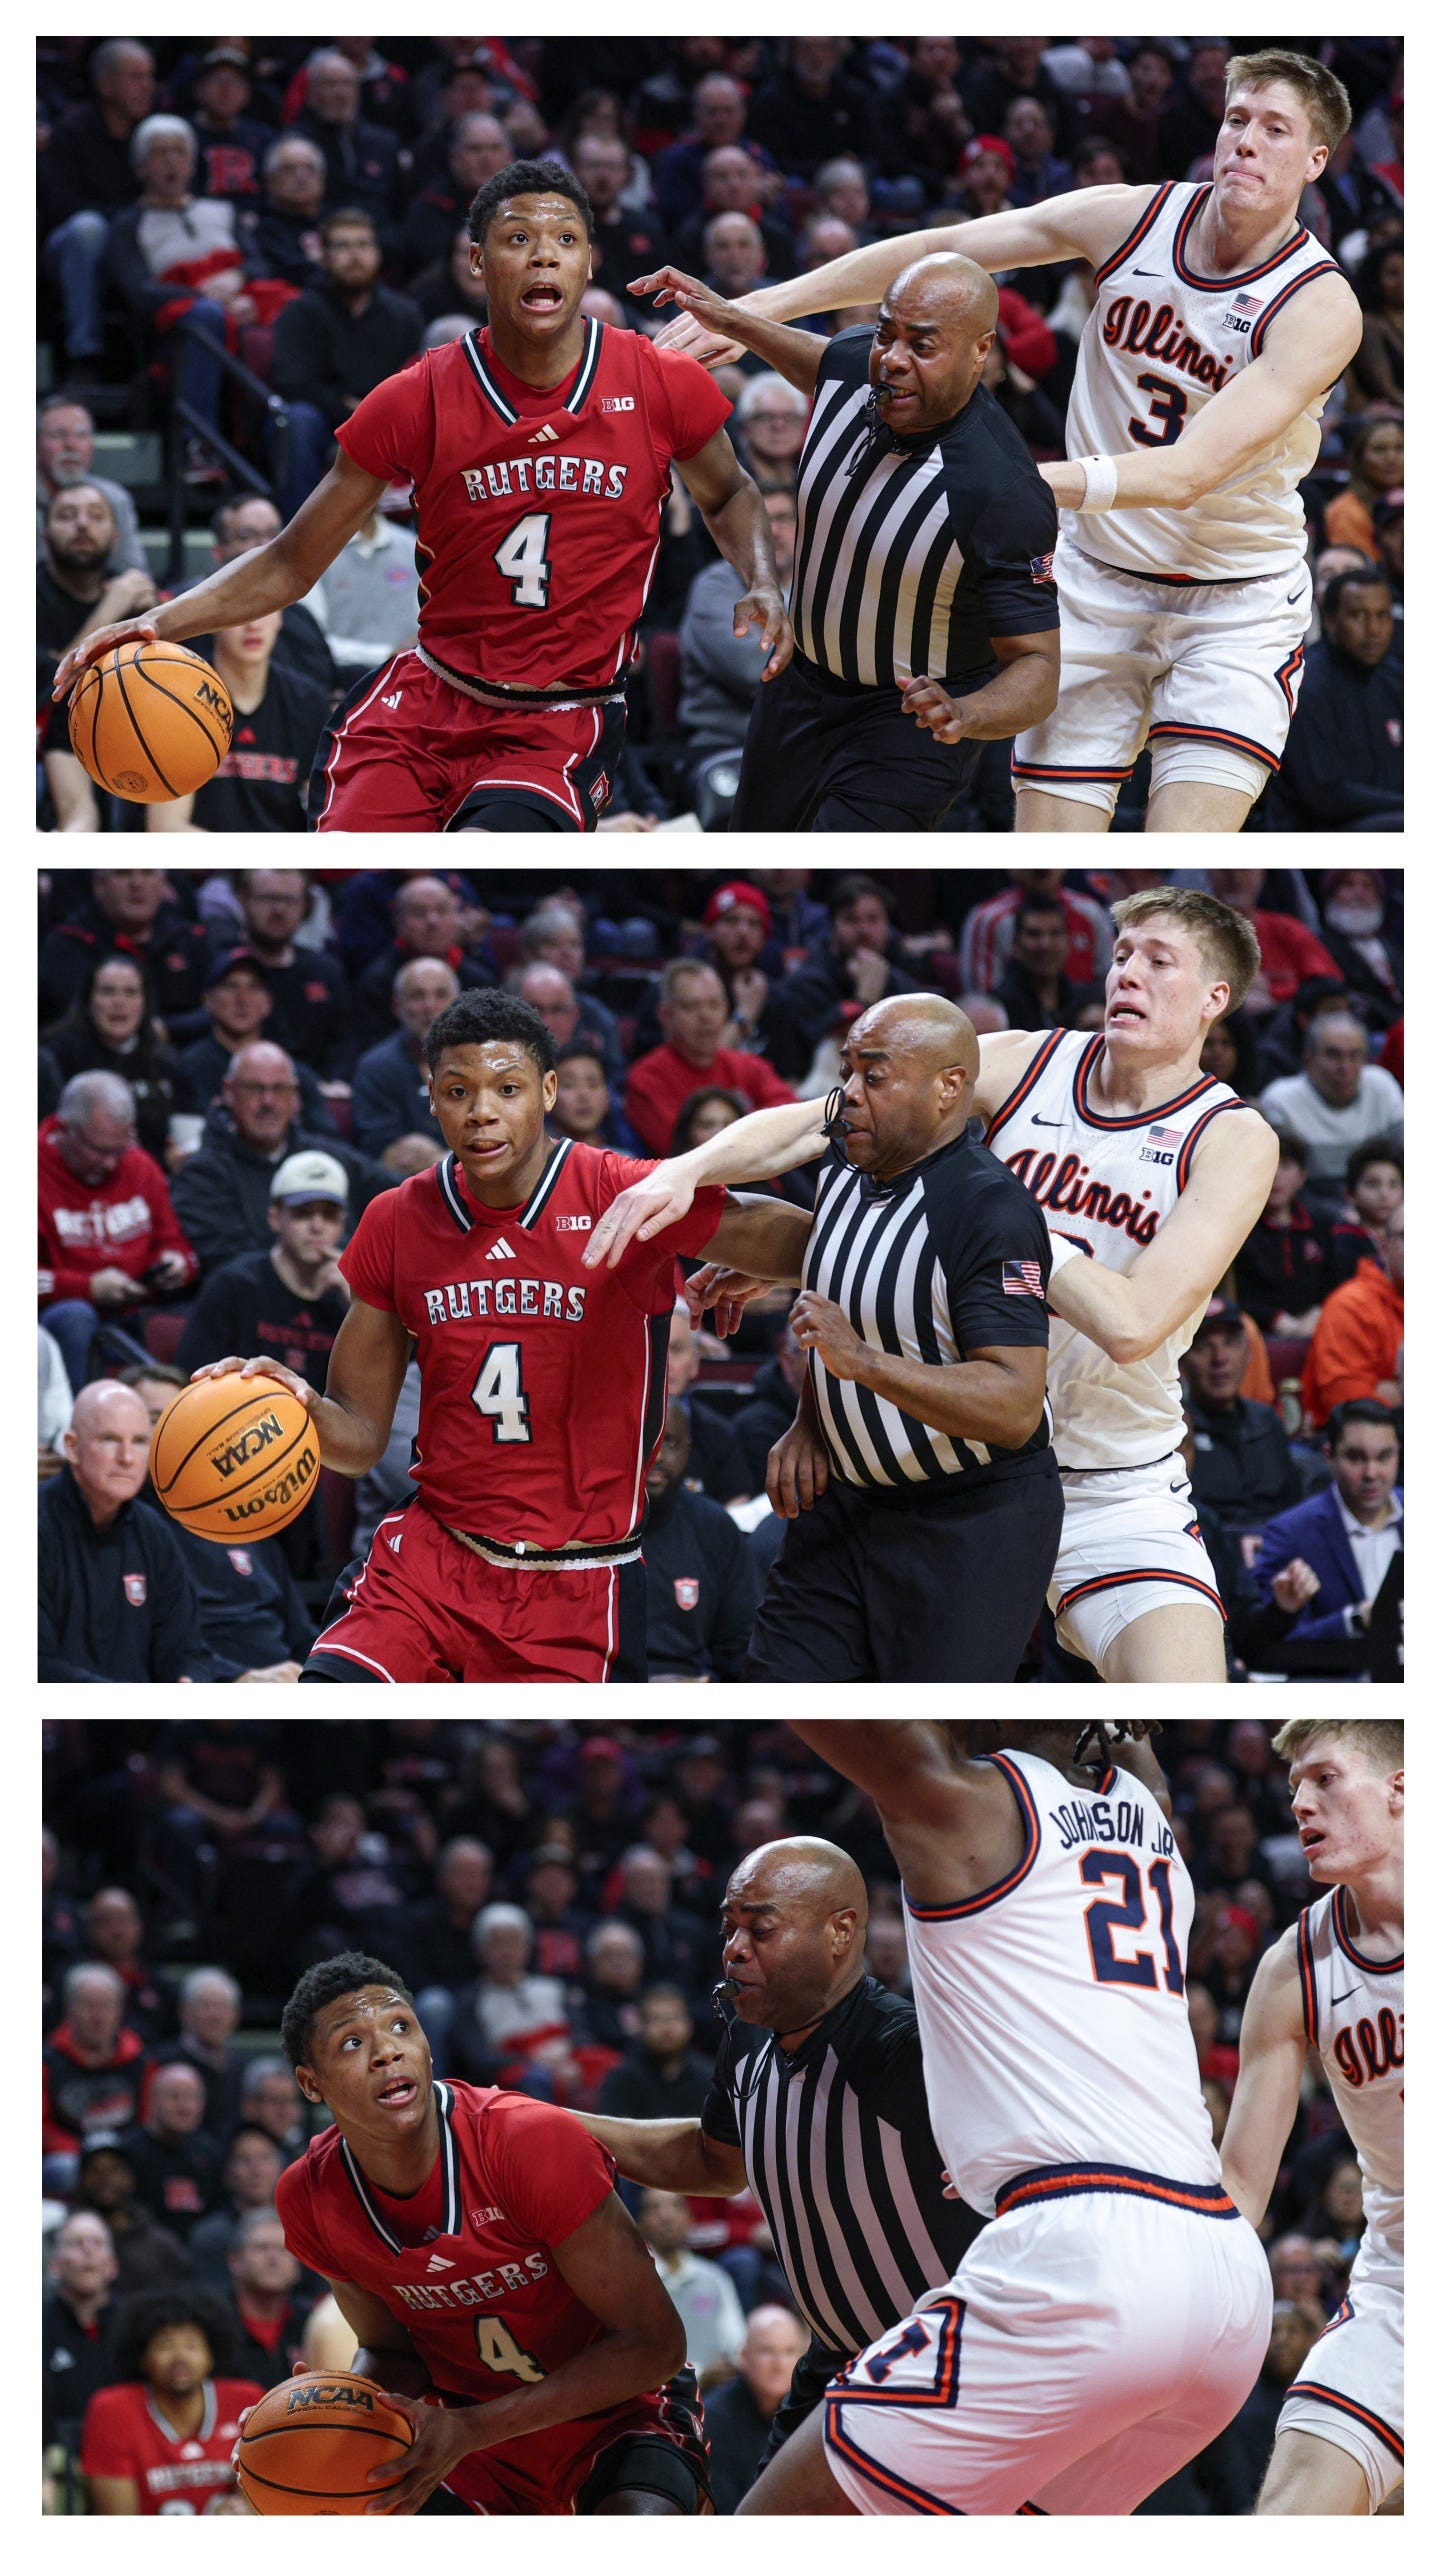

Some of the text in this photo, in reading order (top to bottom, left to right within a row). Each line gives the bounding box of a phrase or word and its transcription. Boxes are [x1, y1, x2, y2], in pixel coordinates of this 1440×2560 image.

[1103, 296, 1236, 393] Illinoi
[1128, 372, 1188, 447] 3
[460, 455, 628, 501] RUTGERS
[494, 512, 552, 609] 4
[1004, 1149, 1160, 1247] Illinois
[423, 1278, 586, 1326] RUTGERS
[470, 1341, 533, 1444] 4
[211, 1412, 284, 1479] NCAA
[223, 1447, 317, 1522] Wilson
[1049, 1800, 1179, 1866] JOHNSON JR
[1078, 1847, 1184, 1998] 21
[392, 2252, 549, 2310] RUTGERS
[474, 2314, 549, 2383] 4
[287, 2385, 374, 2411] NCAA
